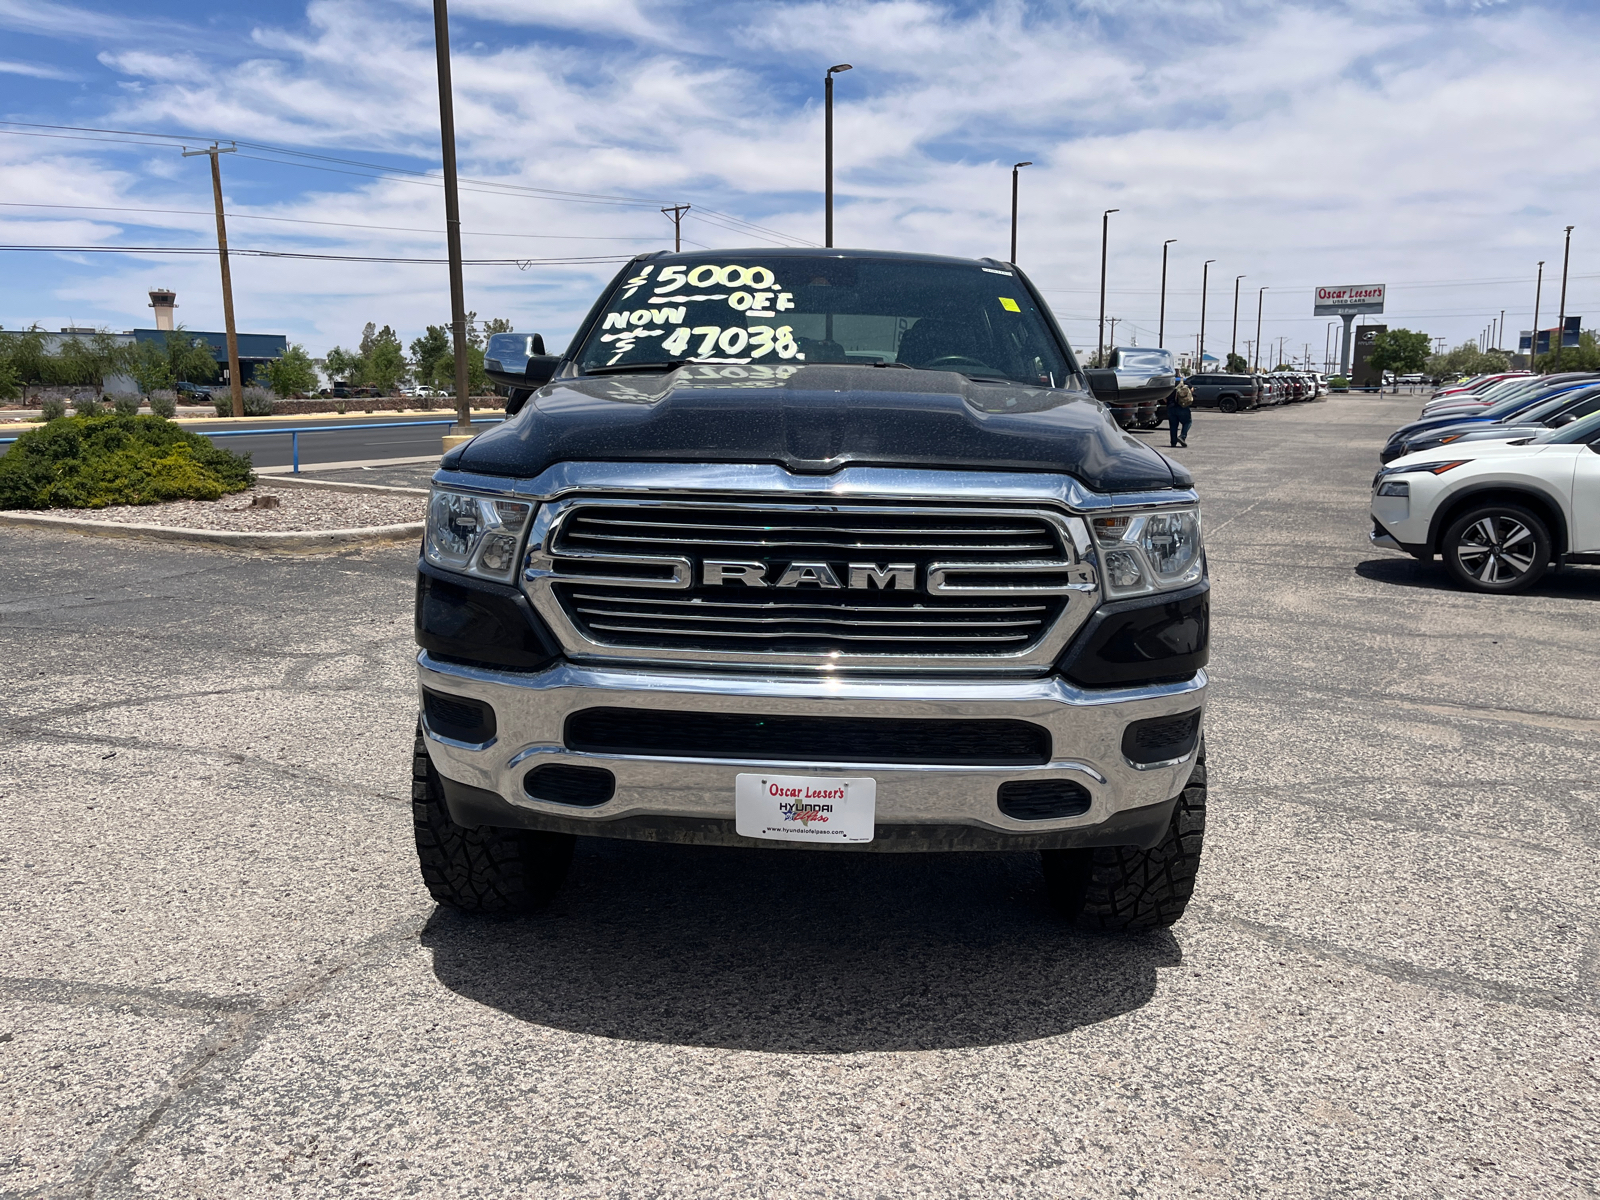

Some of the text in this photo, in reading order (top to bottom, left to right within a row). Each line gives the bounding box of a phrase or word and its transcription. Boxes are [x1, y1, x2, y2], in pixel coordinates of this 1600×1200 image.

[1318, 287, 1382, 299] Oscar Leeser's
[727, 291, 796, 312] OFF
[602, 306, 687, 330] NOW
[702, 559, 917, 590] RAM
[769, 783, 845, 799] Oscar Leeser's
[779, 802, 833, 813] HYUNDAI
[766, 826, 845, 835] www.hyundaiofelpaso.com
